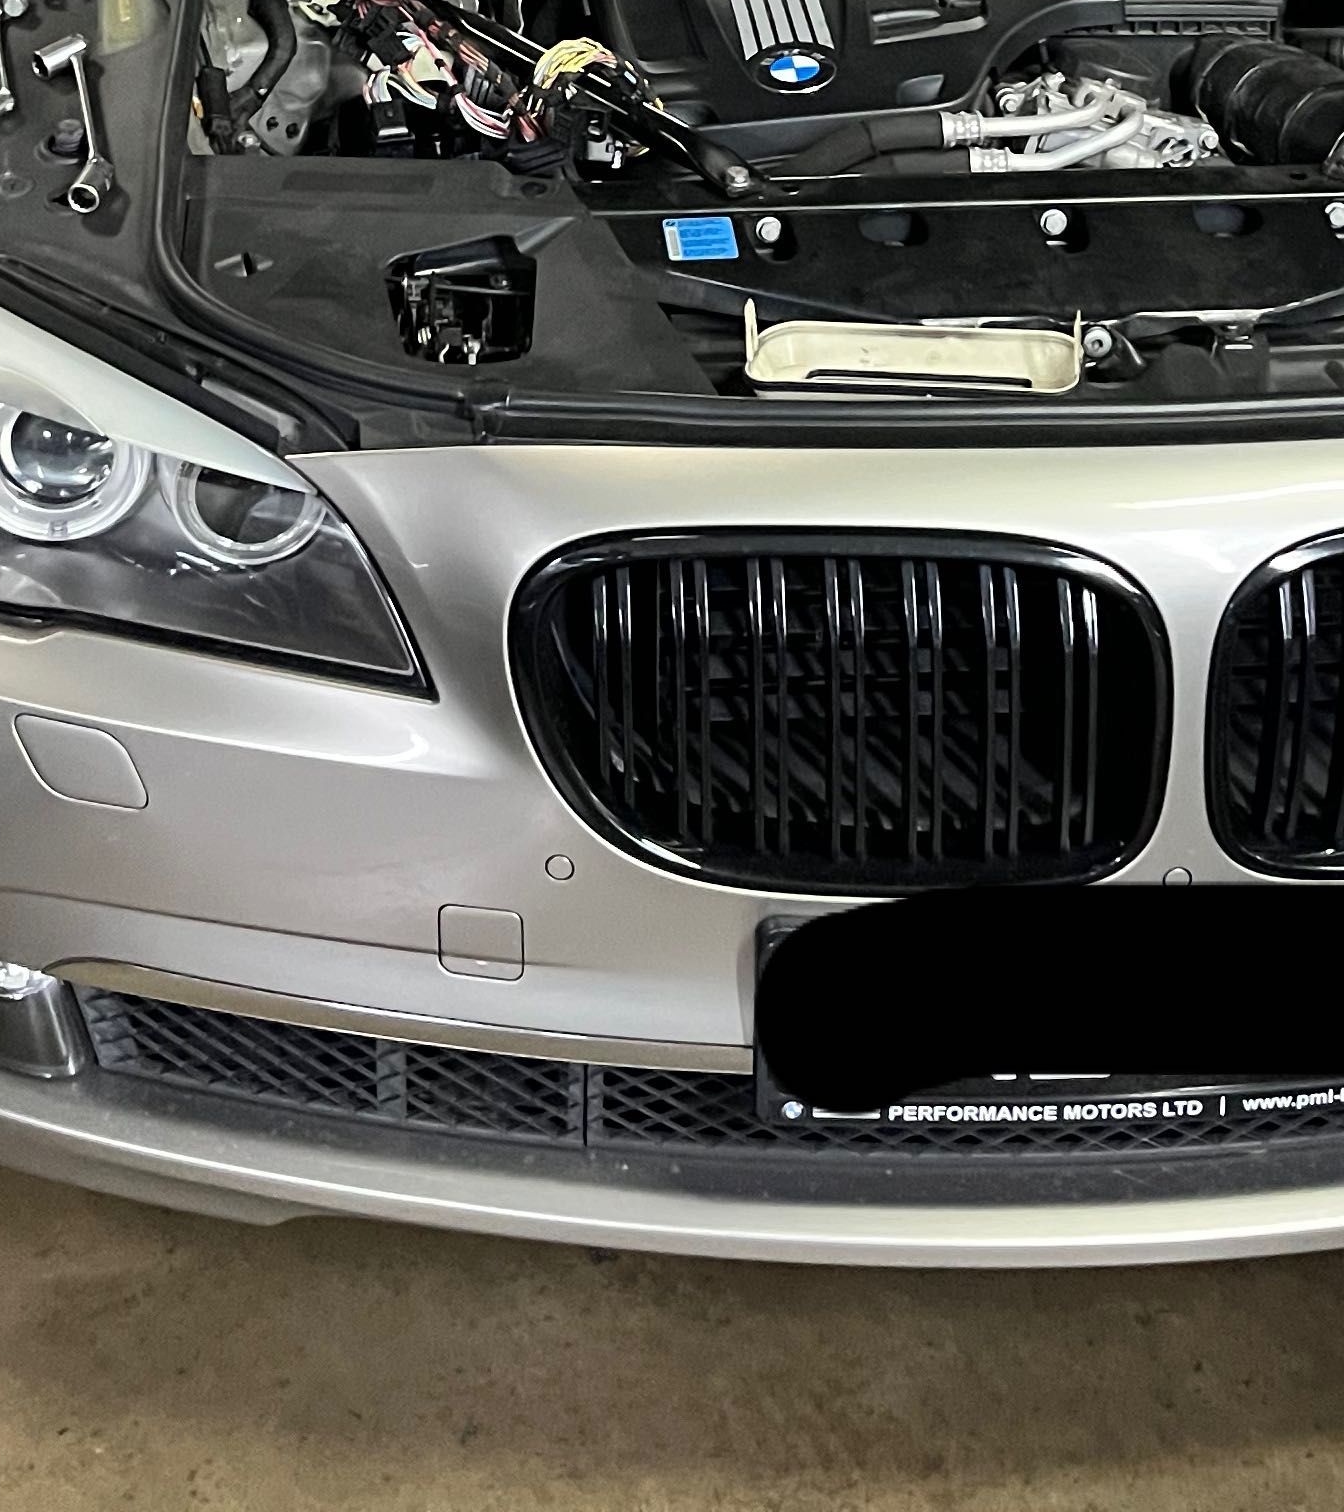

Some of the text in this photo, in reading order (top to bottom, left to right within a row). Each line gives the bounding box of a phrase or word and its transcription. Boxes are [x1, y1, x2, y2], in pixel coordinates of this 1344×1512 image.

[888, 1105, 1057, 1122] PERFORMANCE
[1063, 1102, 1157, 1120] MOTORS
[1162, 1100, 1203, 1117] LTD
